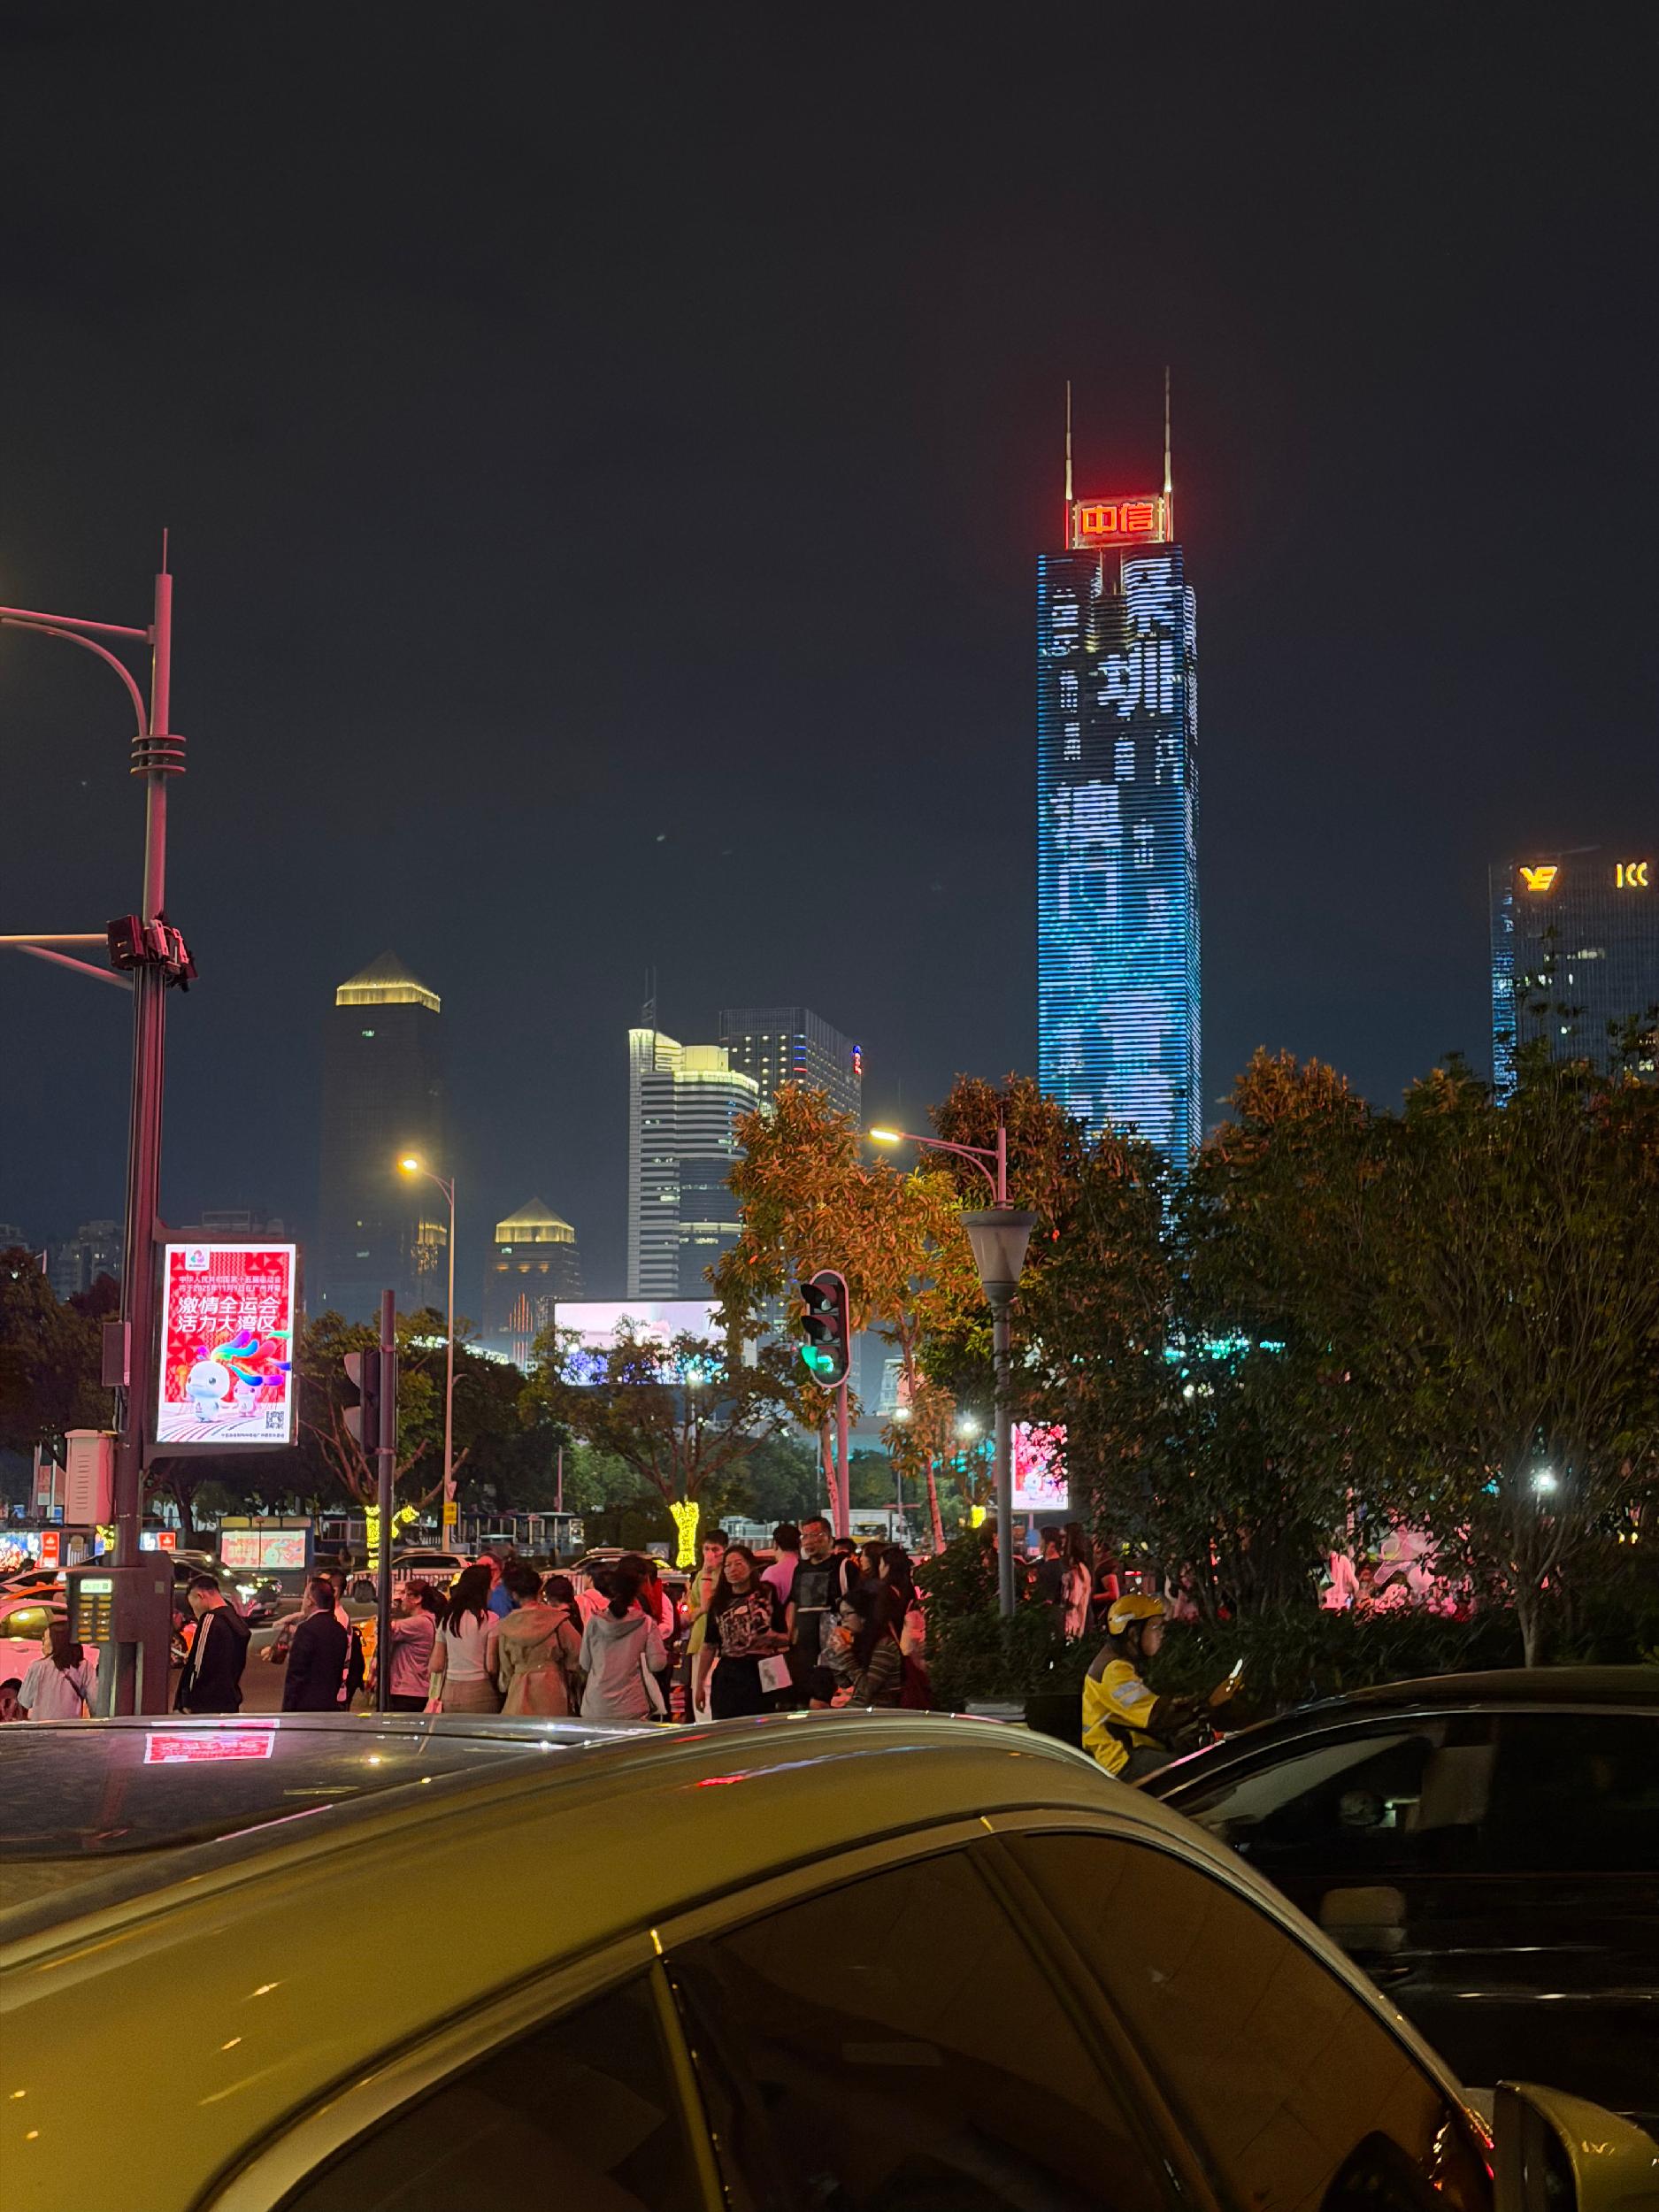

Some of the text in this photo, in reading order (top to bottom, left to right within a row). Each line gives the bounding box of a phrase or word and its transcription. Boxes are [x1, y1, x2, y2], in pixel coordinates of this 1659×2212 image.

[1081, 502, 1154, 535] 中信
[177, 1295, 281, 1315] 激情全运会
[176, 1314, 278, 1333] 活力大湾区
